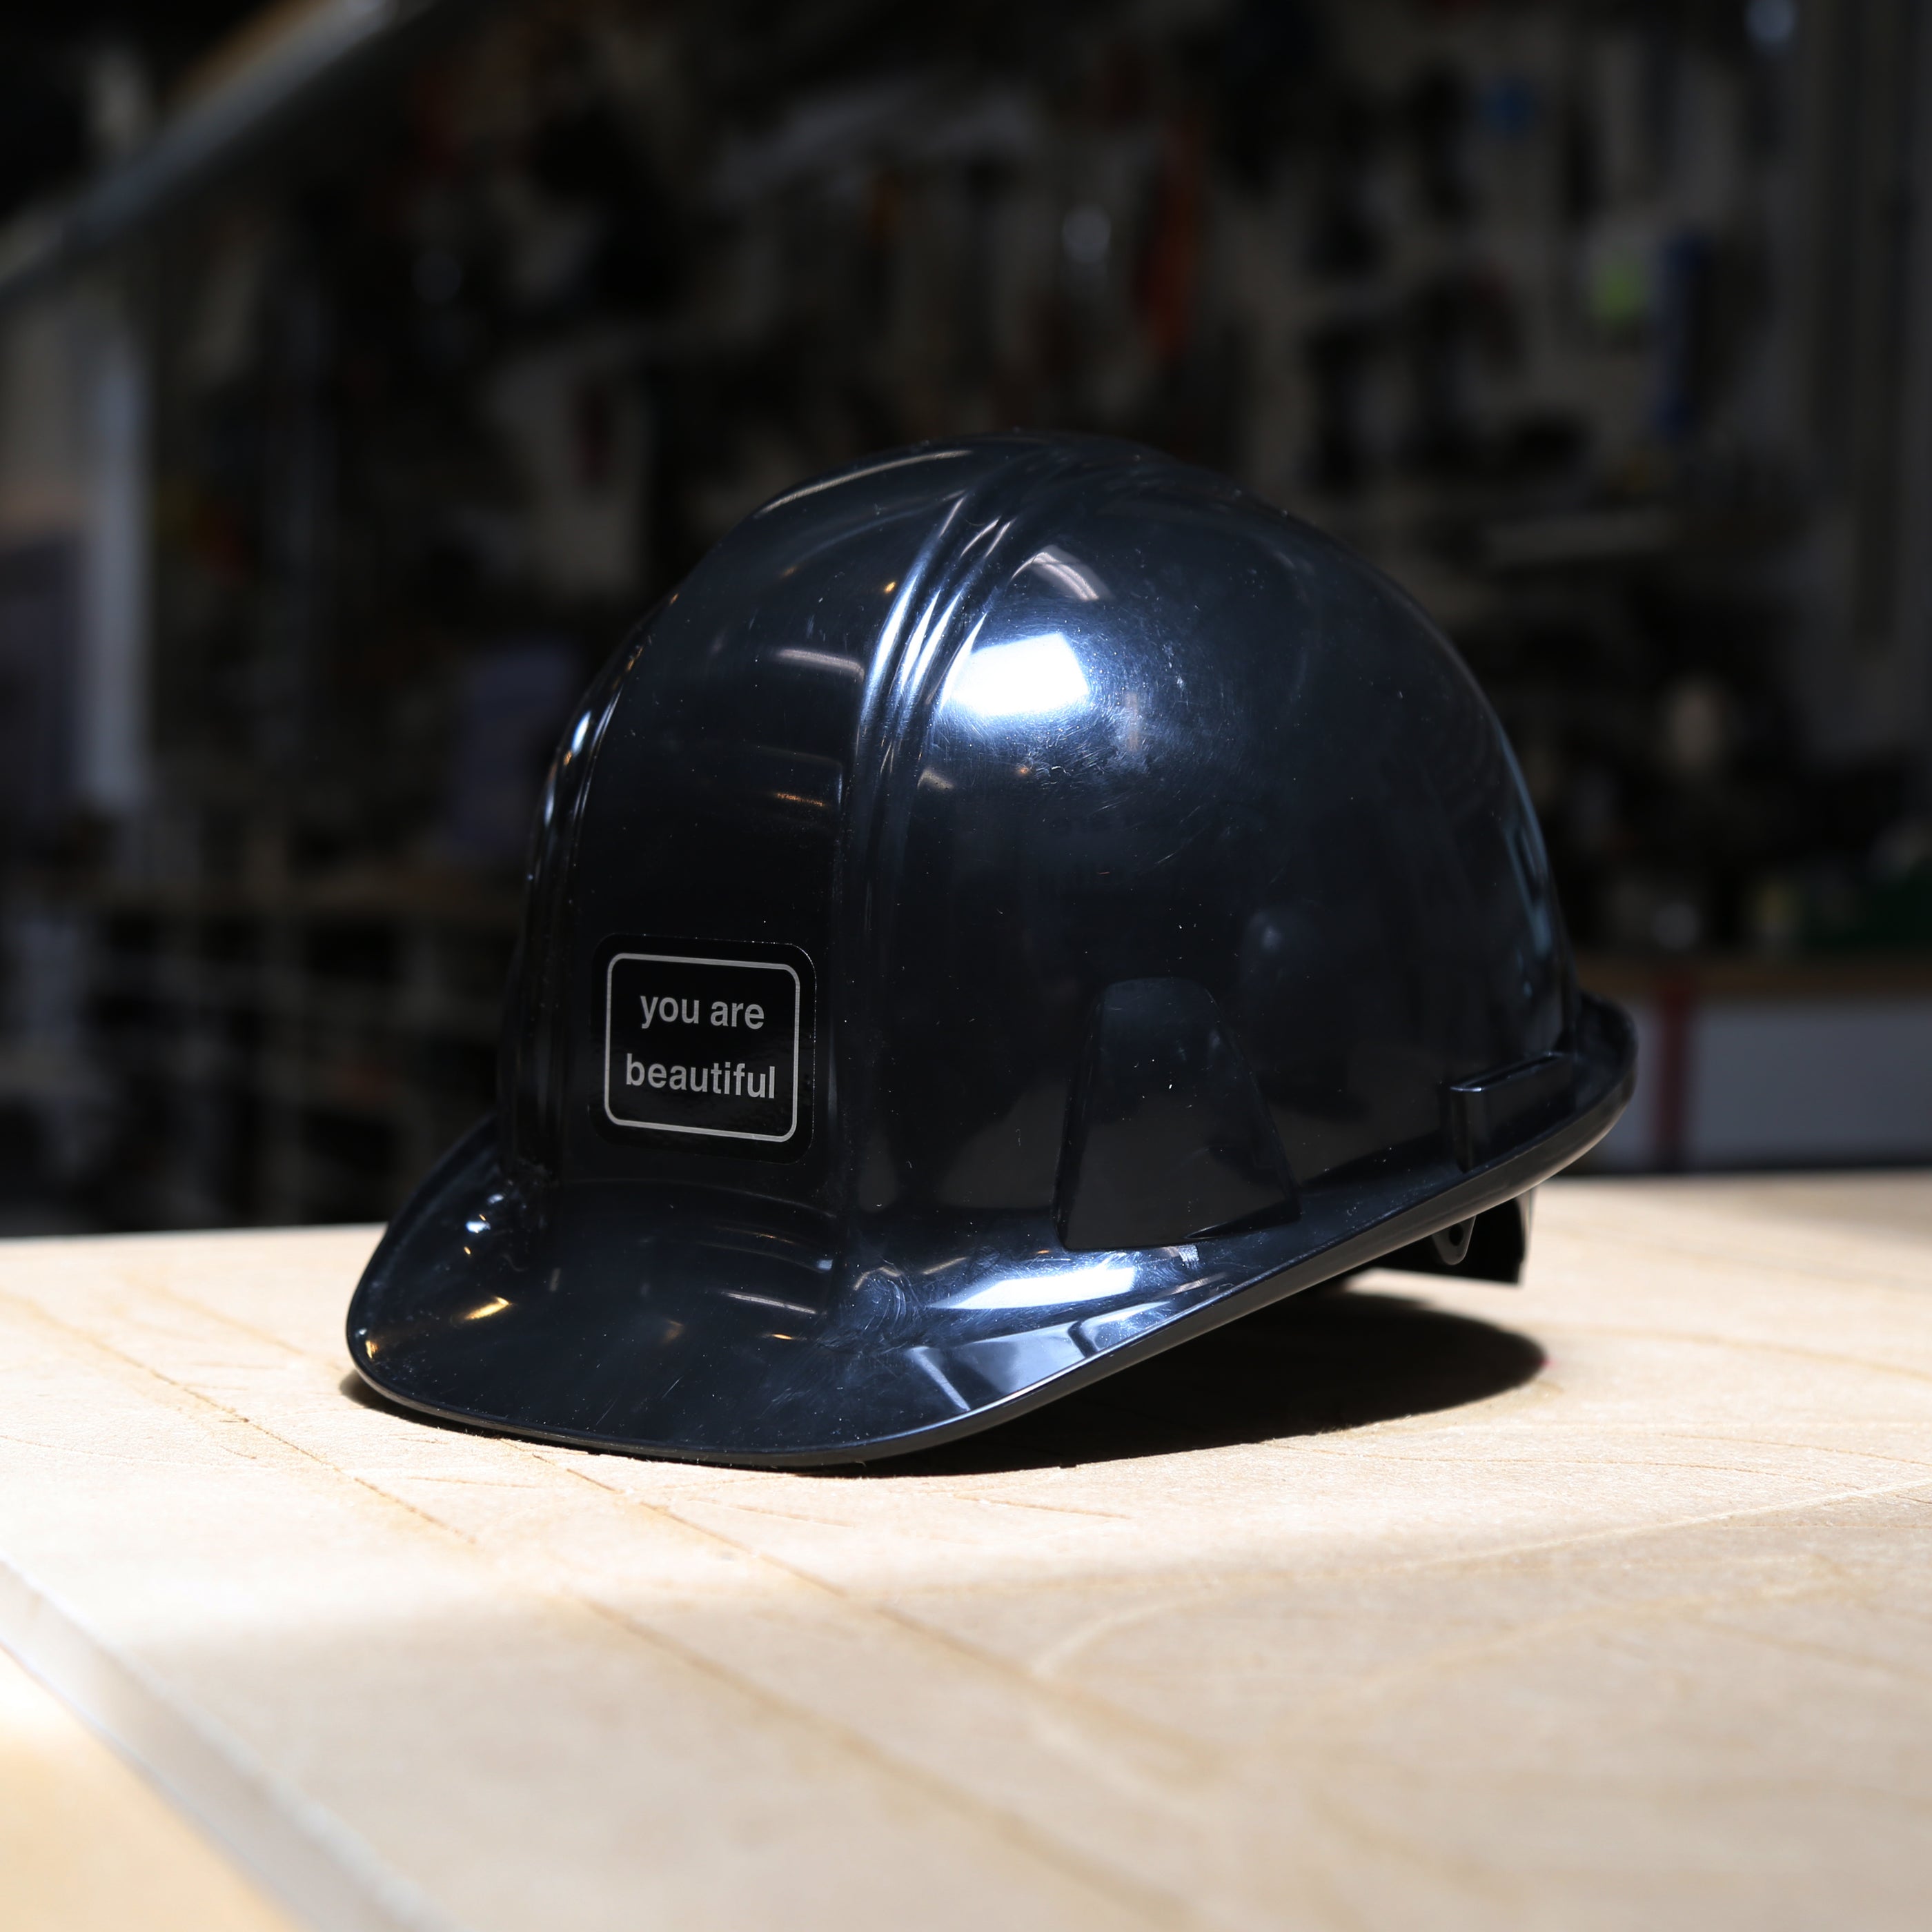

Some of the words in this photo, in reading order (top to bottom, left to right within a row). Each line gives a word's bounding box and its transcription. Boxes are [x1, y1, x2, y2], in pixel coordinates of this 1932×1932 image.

[640, 996, 700, 1029] you
[711, 1001, 765, 1029] are
[626, 1053, 776, 1099] beautiful
